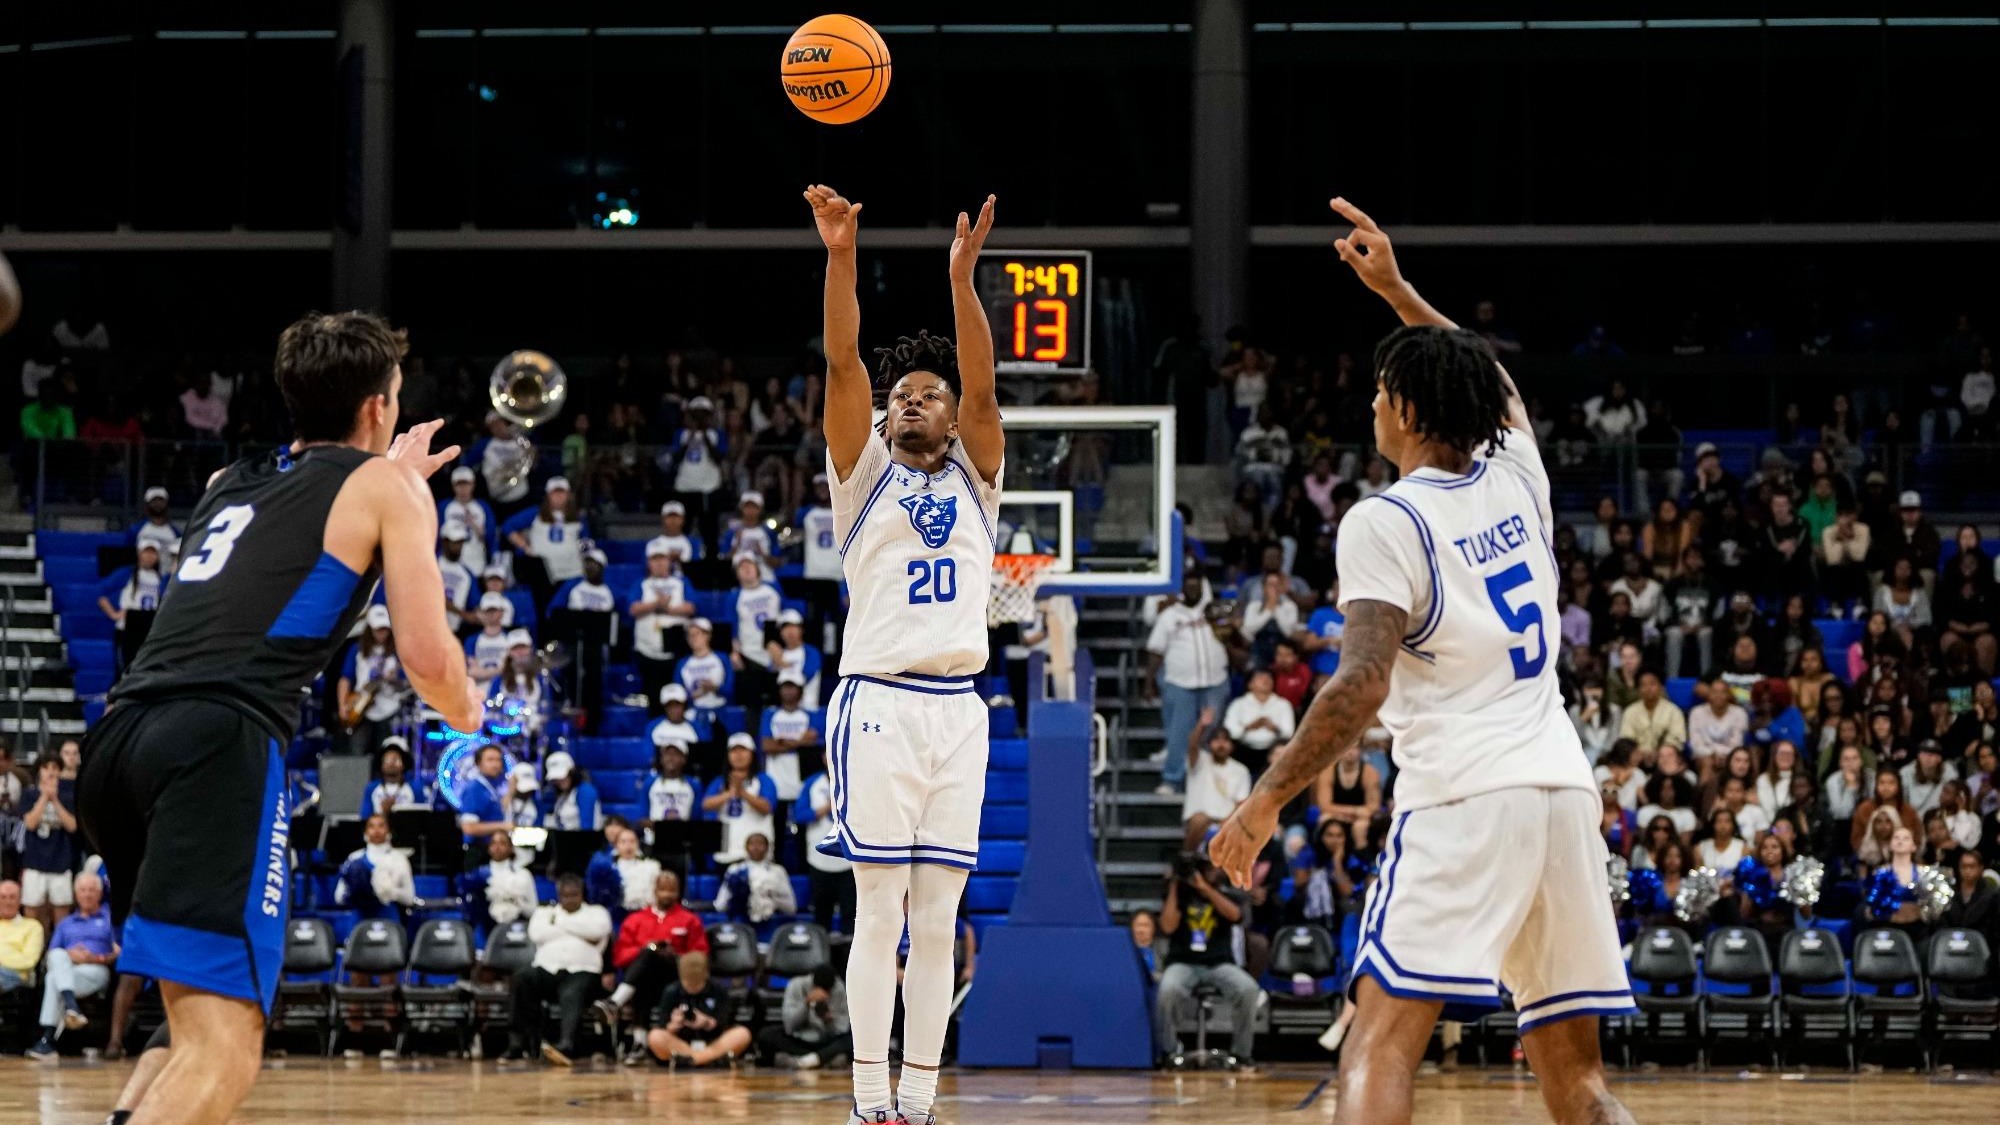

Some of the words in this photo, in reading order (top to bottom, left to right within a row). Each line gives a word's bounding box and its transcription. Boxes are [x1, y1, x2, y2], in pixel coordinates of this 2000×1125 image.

[787, 48, 833, 65] NCAA
[783, 80, 850, 102] Wilson
[1004, 263, 1078, 296] 7:47
[1014, 299, 1067, 360] 13
[179, 504, 255, 581] 3
[1454, 514, 1530, 567] TUKER
[908, 558, 956, 604] 20
[1484, 561, 1548, 682] 5
